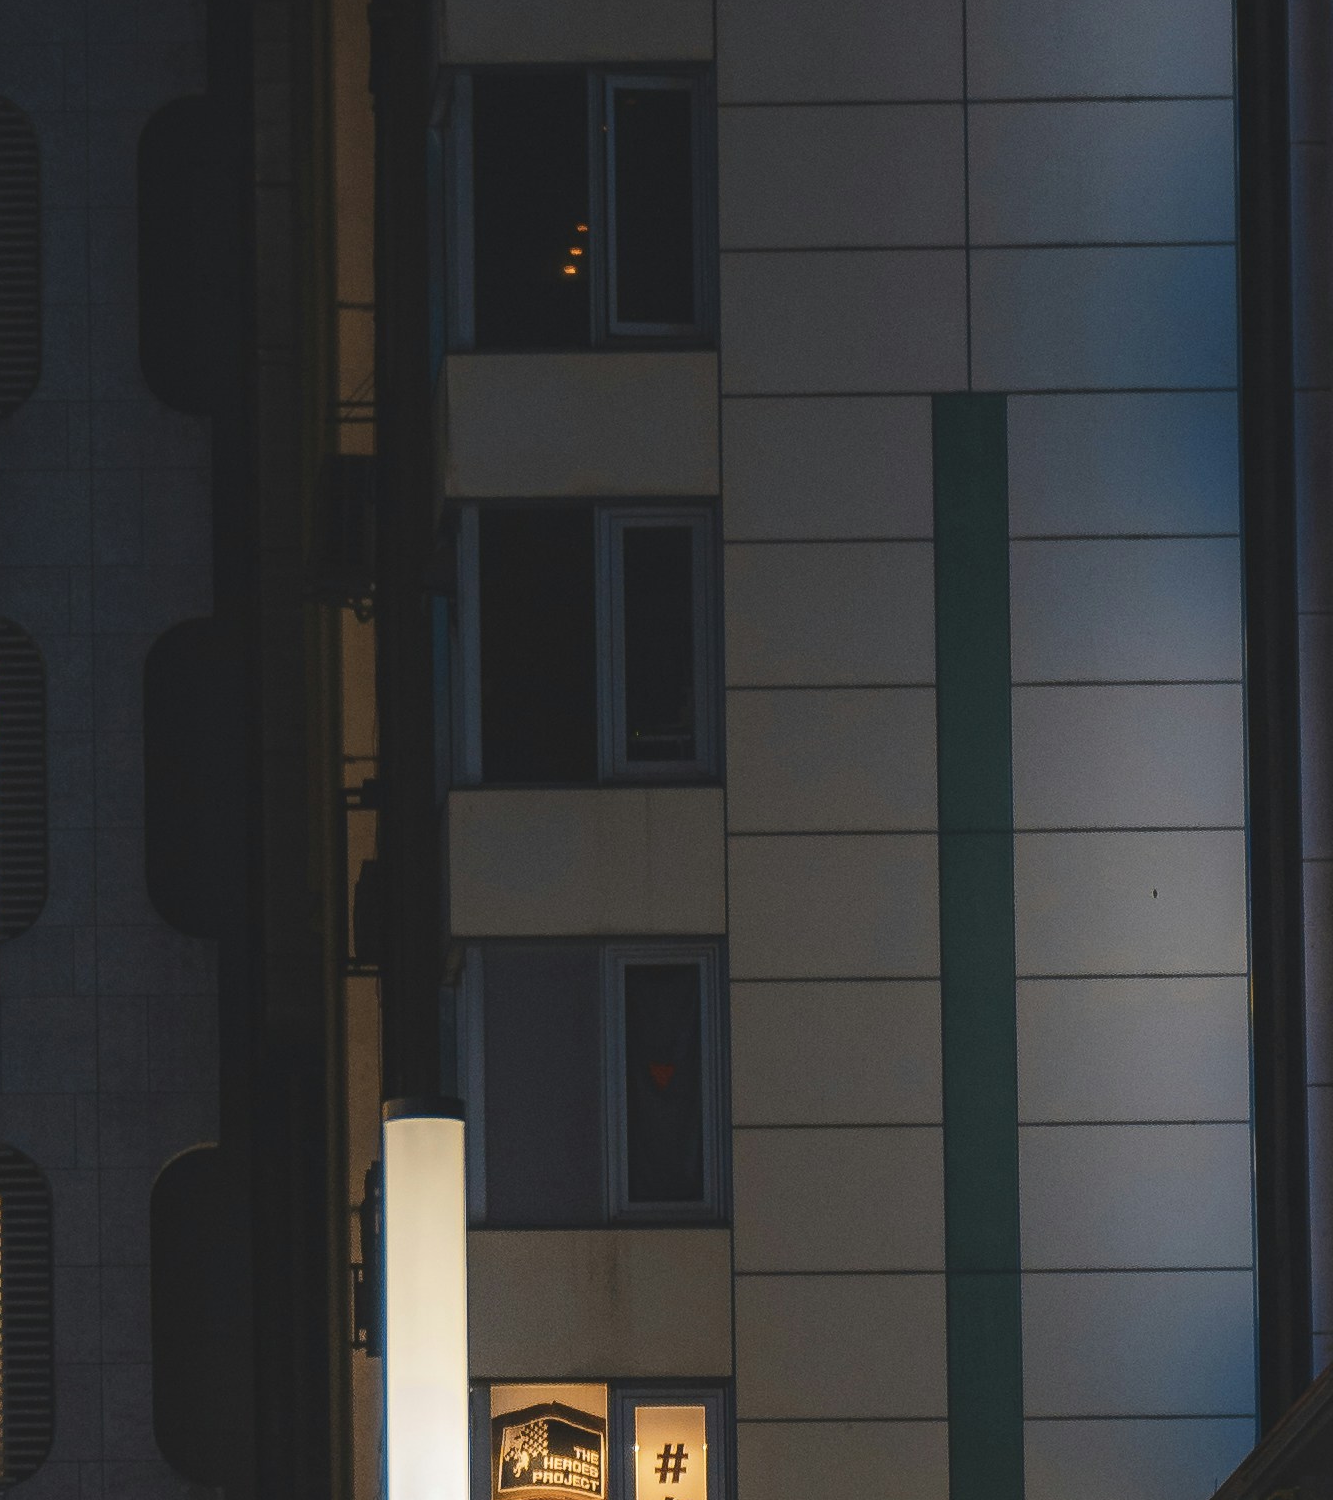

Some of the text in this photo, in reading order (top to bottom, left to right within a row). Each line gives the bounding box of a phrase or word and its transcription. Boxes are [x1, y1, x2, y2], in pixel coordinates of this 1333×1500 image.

[573, 1446, 600, 1464] THE
[543, 1457, 601, 1479] HEROES
[532, 1471, 601, 1493] PROJECT
